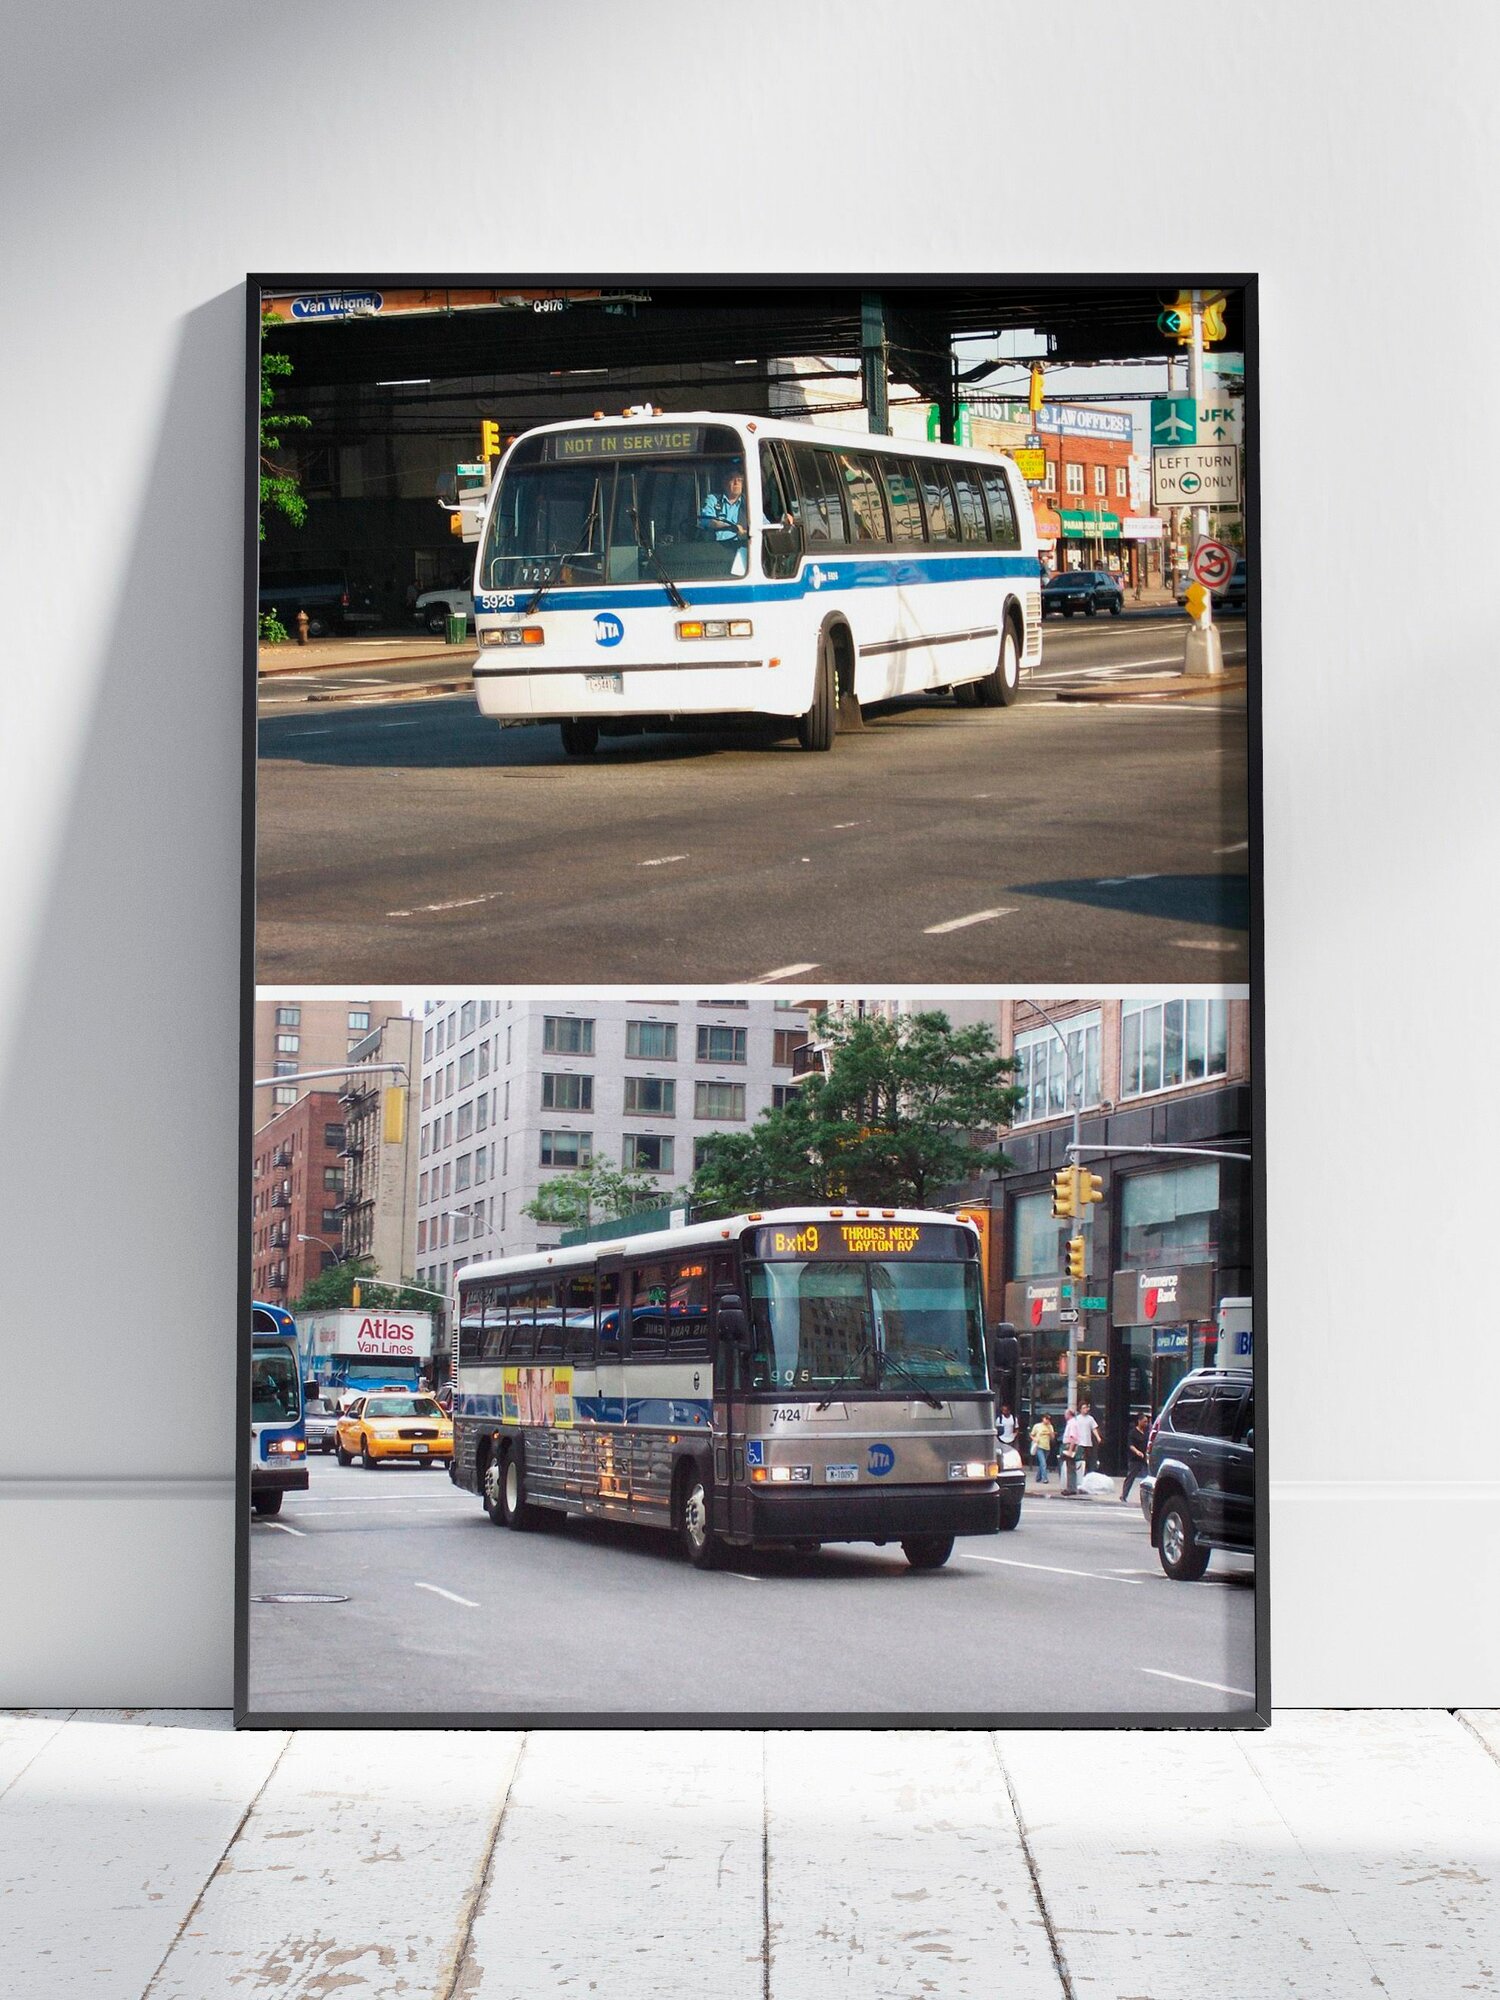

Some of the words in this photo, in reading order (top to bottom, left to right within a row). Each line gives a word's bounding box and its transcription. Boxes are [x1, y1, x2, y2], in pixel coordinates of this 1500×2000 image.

[300, 300, 325, 313] Van
[533, 299, 563, 312] Q-9176
[1052, 407, 1077, 426] LAW
[1077, 411, 1124, 432] OFFICES
[1199, 409, 1236, 422] JFK
[564, 439, 594, 454] NOT
[601, 437, 617, 451] IN
[623, 433, 692, 450] SERVICE
[1159, 457, 1191, 469] LEFT
[1197, 455, 1232, 468] TURN
[1160, 478, 1176, 490] ON
[1204, 475, 1234, 488] ONLY
[482, 594, 515, 609] 5926
[593, 620, 620, 641] MTA
[775, 1226, 819, 1252] BxM9
[841, 1227, 886, 1240] THROGS
[889, 1227, 919, 1240] NECK
[849, 1240, 894, 1252] LAYTON
[897, 1240, 914, 1252] AV
[1140, 1274, 1178, 1289] Commerce
[1157, 1287, 1177, 1303] Bank
[357, 1318, 414, 1341] Atlas
[1171, 1334, 1176, 1346] 7
[357, 1341, 379, 1353] Van
[382, 1342, 414, 1355] Lines
[772, 1409, 801, 1421] 7424
[867, 1451, 890, 1469] MTA
